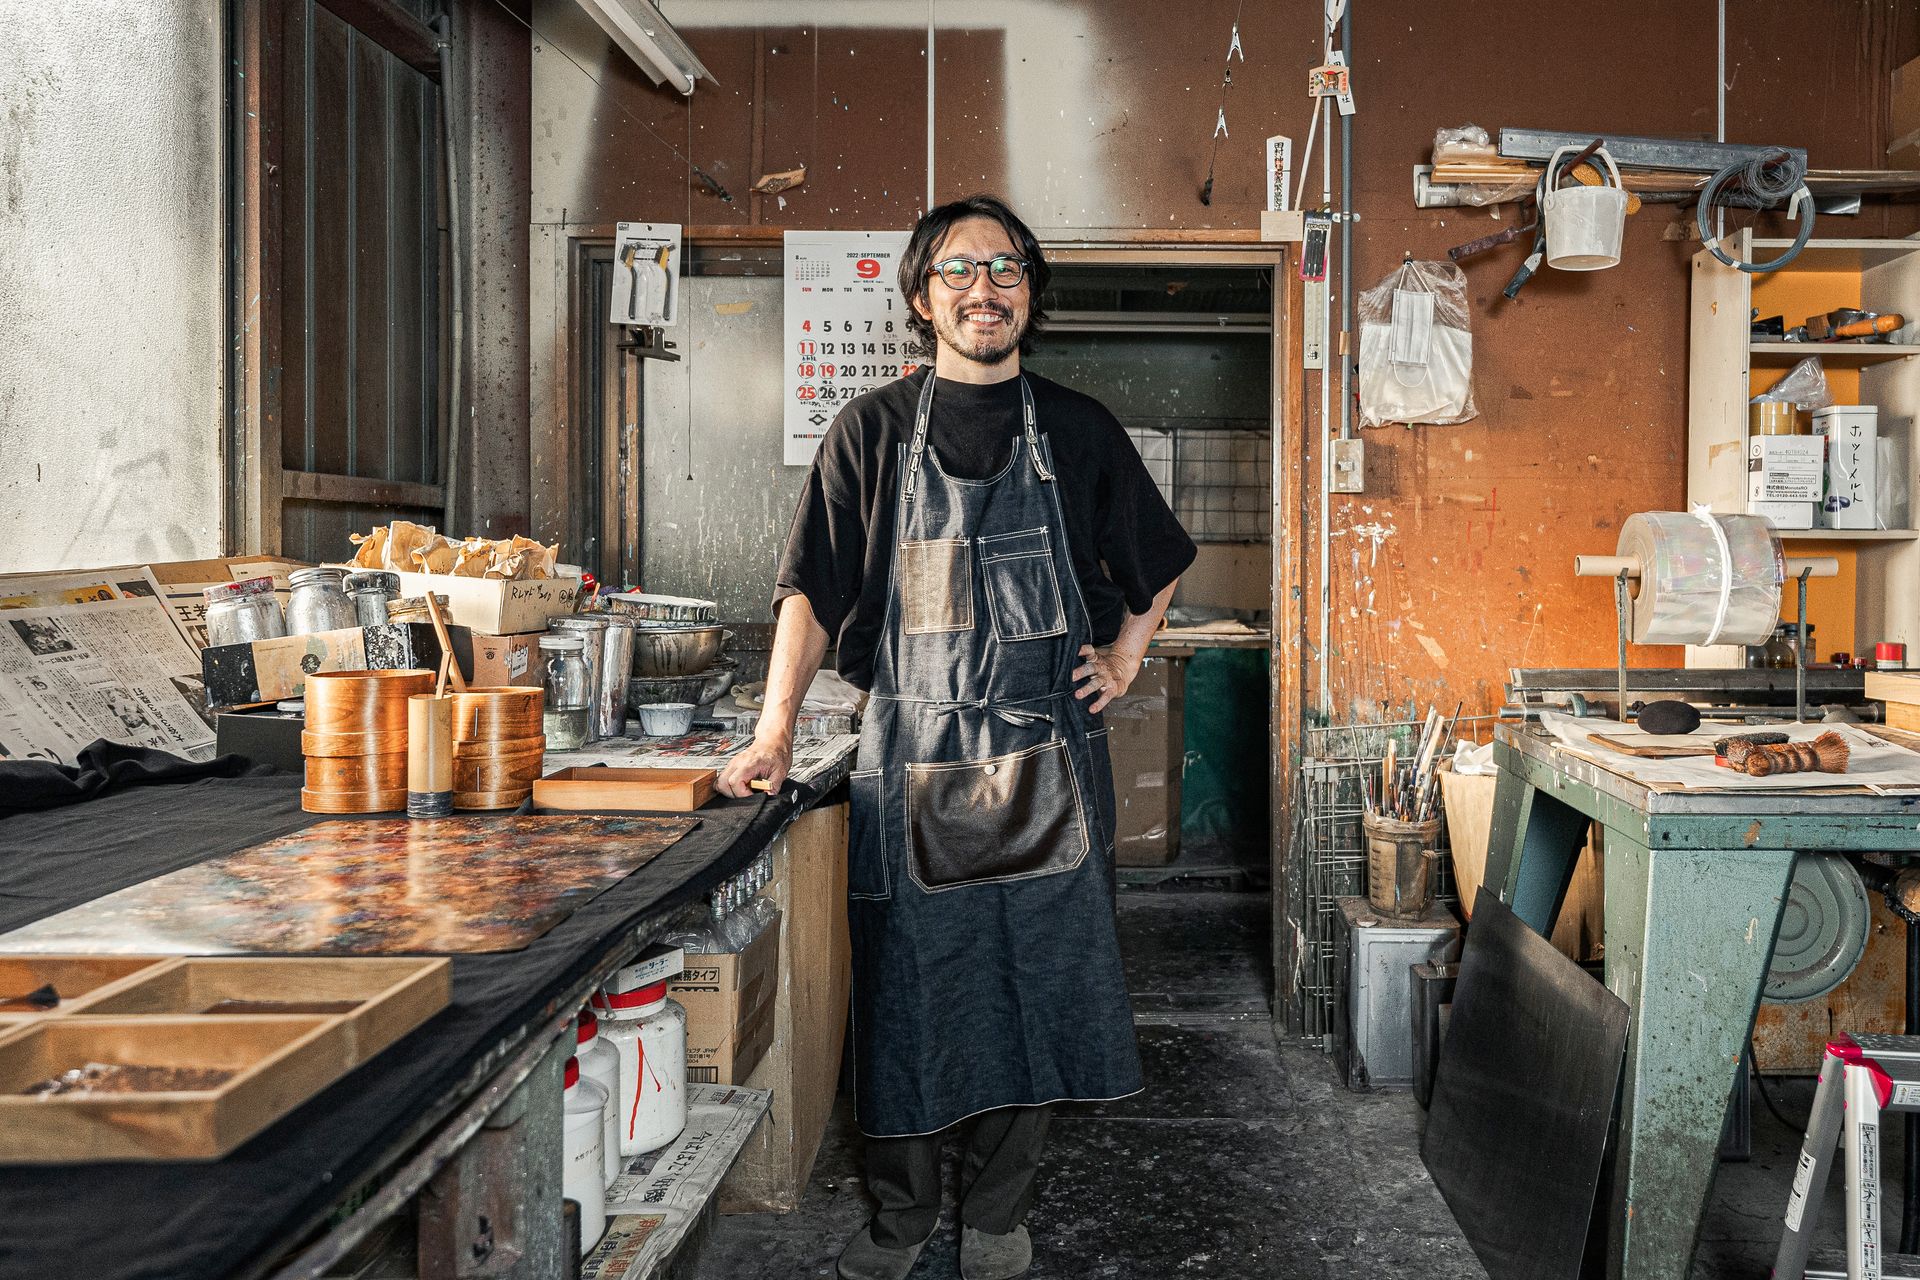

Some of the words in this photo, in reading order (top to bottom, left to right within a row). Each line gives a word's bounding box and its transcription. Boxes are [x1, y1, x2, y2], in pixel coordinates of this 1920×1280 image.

[856, 258, 881, 279] 9
[886, 298, 892, 311] 1
[802, 320, 812, 333] 4
[823, 320, 832, 333] 5
[844, 320, 852, 333] 6
[864, 320, 873, 333] 7
[885, 320, 894, 333] 8
[799, 342, 815, 355] 11
[820, 342, 835, 355] 12
[841, 342, 856, 355] 13
[861, 342, 876, 355] 14
[882, 342, 897, 355] 15
[799, 365, 815, 377] 18
[820, 365, 835, 377] 19
[840, 365, 857, 377] 20
[861, 365, 877, 377] 21
[881, 365, 898, 377] 22
[799, 387, 817, 399] 25
[820, 387, 837, 399] 26
[840, 387, 857, 400] 27
[1850, 425, 1863, 503] ホットメルト
